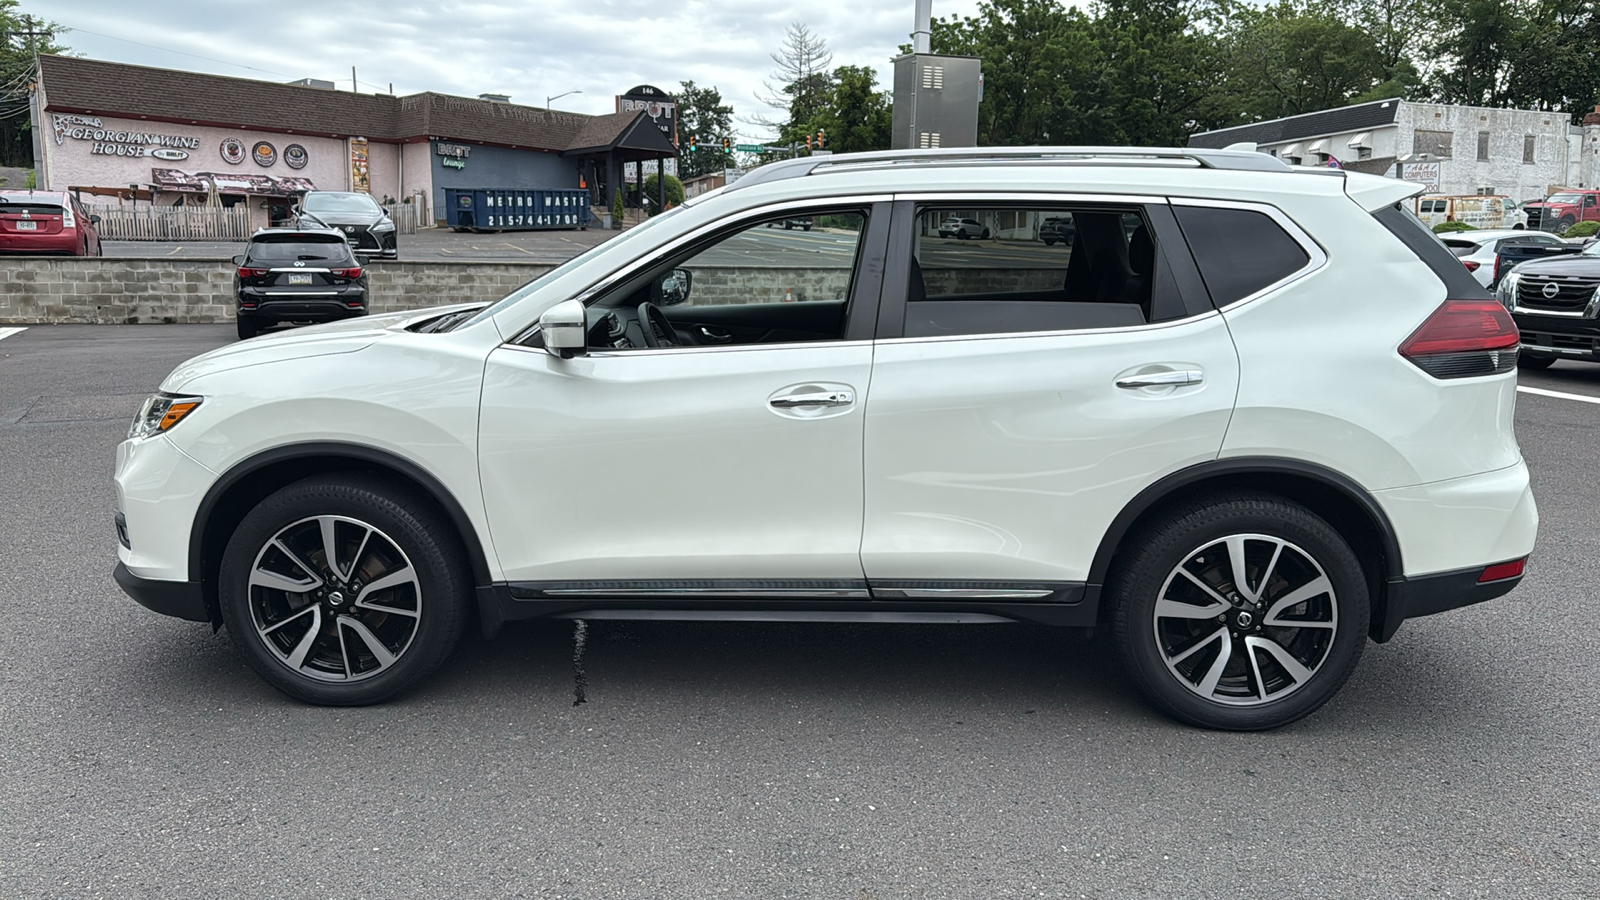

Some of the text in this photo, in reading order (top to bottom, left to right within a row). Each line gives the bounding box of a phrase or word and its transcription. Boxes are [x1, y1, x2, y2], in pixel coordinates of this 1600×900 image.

[71, 127, 200, 149] GEORGIAN WINE
[92, 142, 145, 157] HOUSE
[437, 143, 471, 158] BRUT
[1404, 170, 1438, 178] COMPUTERS
[486, 196, 584, 207] METRO WASTE
